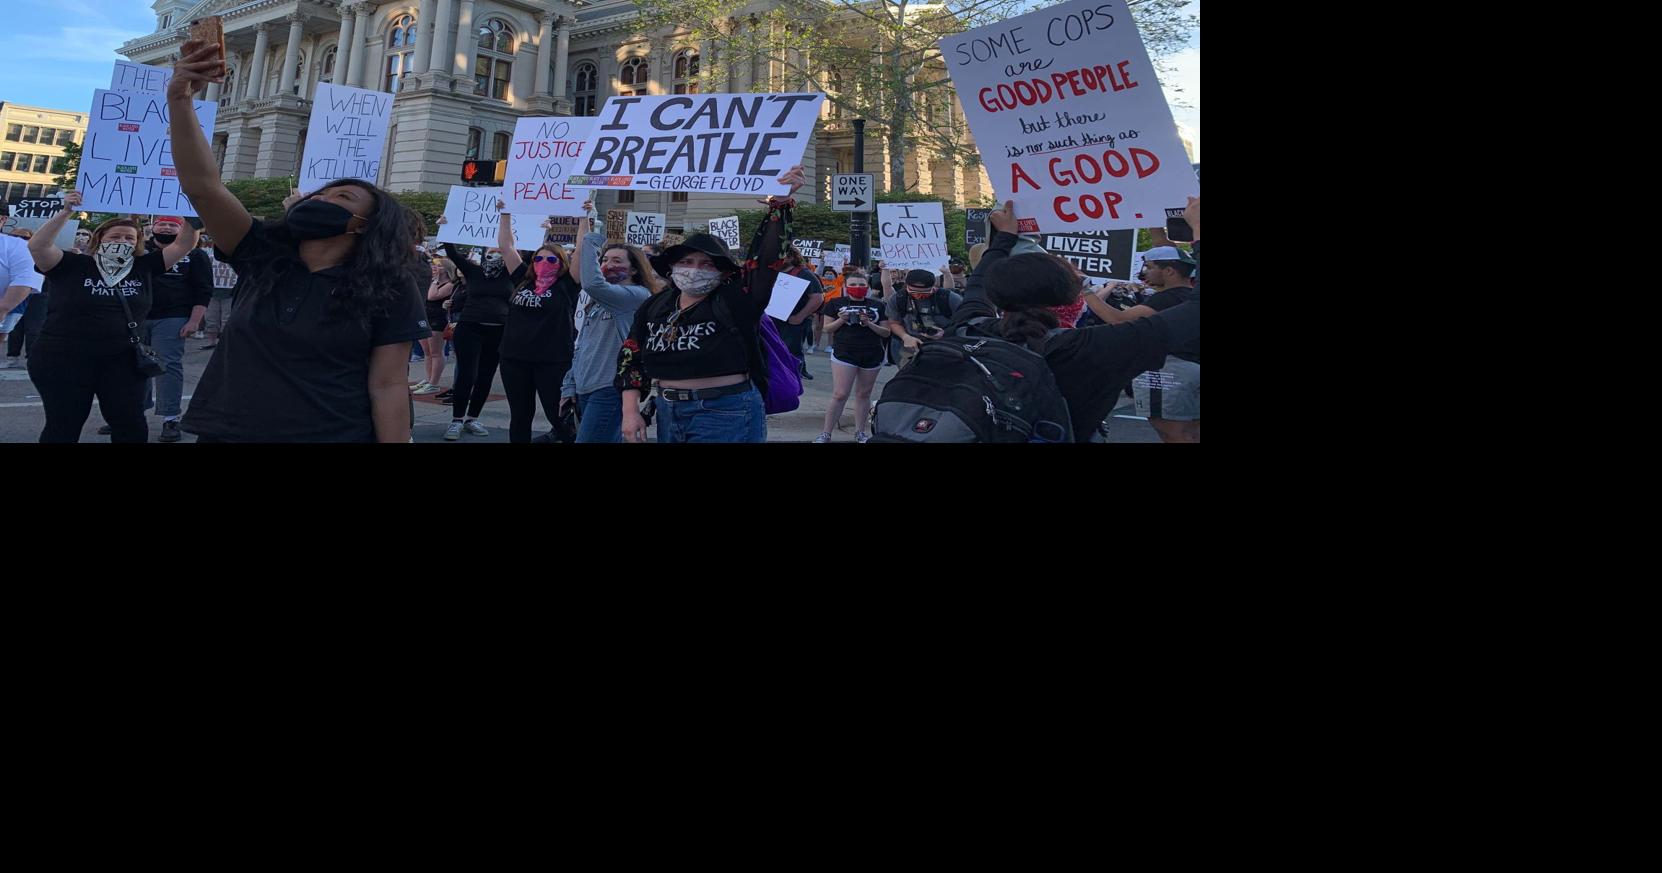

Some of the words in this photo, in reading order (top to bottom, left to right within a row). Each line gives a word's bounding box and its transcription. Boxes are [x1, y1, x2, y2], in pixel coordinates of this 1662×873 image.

[956, 26, 1031, 66] SOME
[1047, 4, 1114, 46] COPS
[1005, 56, 1054, 77] are
[978, 77, 1052, 113] GOOD
[1050, 60, 1138, 100] PEOPLE
[330, 88, 387, 118] WHEN
[600, 97, 641, 131] I
[650, 95, 818, 131] CAN'T
[326, 116, 377, 137] WILL
[536, 121, 570, 139] NO
[1019, 115, 1051, 134] but
[1055, 111, 1106, 128] there
[336, 137, 370, 157] THE
[1004, 145, 1024, 158] is
[1048, 136, 1078, 150] such
[1081, 132, 1115, 149] thing
[1119, 129, 1140, 140] as
[584, 132, 798, 176] BREATHE
[532, 163, 562, 180] NO
[1011, 162, 1041, 193] A
[1049, 147, 1160, 187] GOOD
[712, 177, 763, 192] FLOYD
[838, 186, 867, 195] WAY
[839, 176, 866, 185] ONE
[514, 182, 575, 200] PEACE
[635, 215, 656, 225] WE
[897, 205, 919, 218] I
[710, 220, 737, 231] BLACK
[1051, 237, 1102, 254] LIVES
